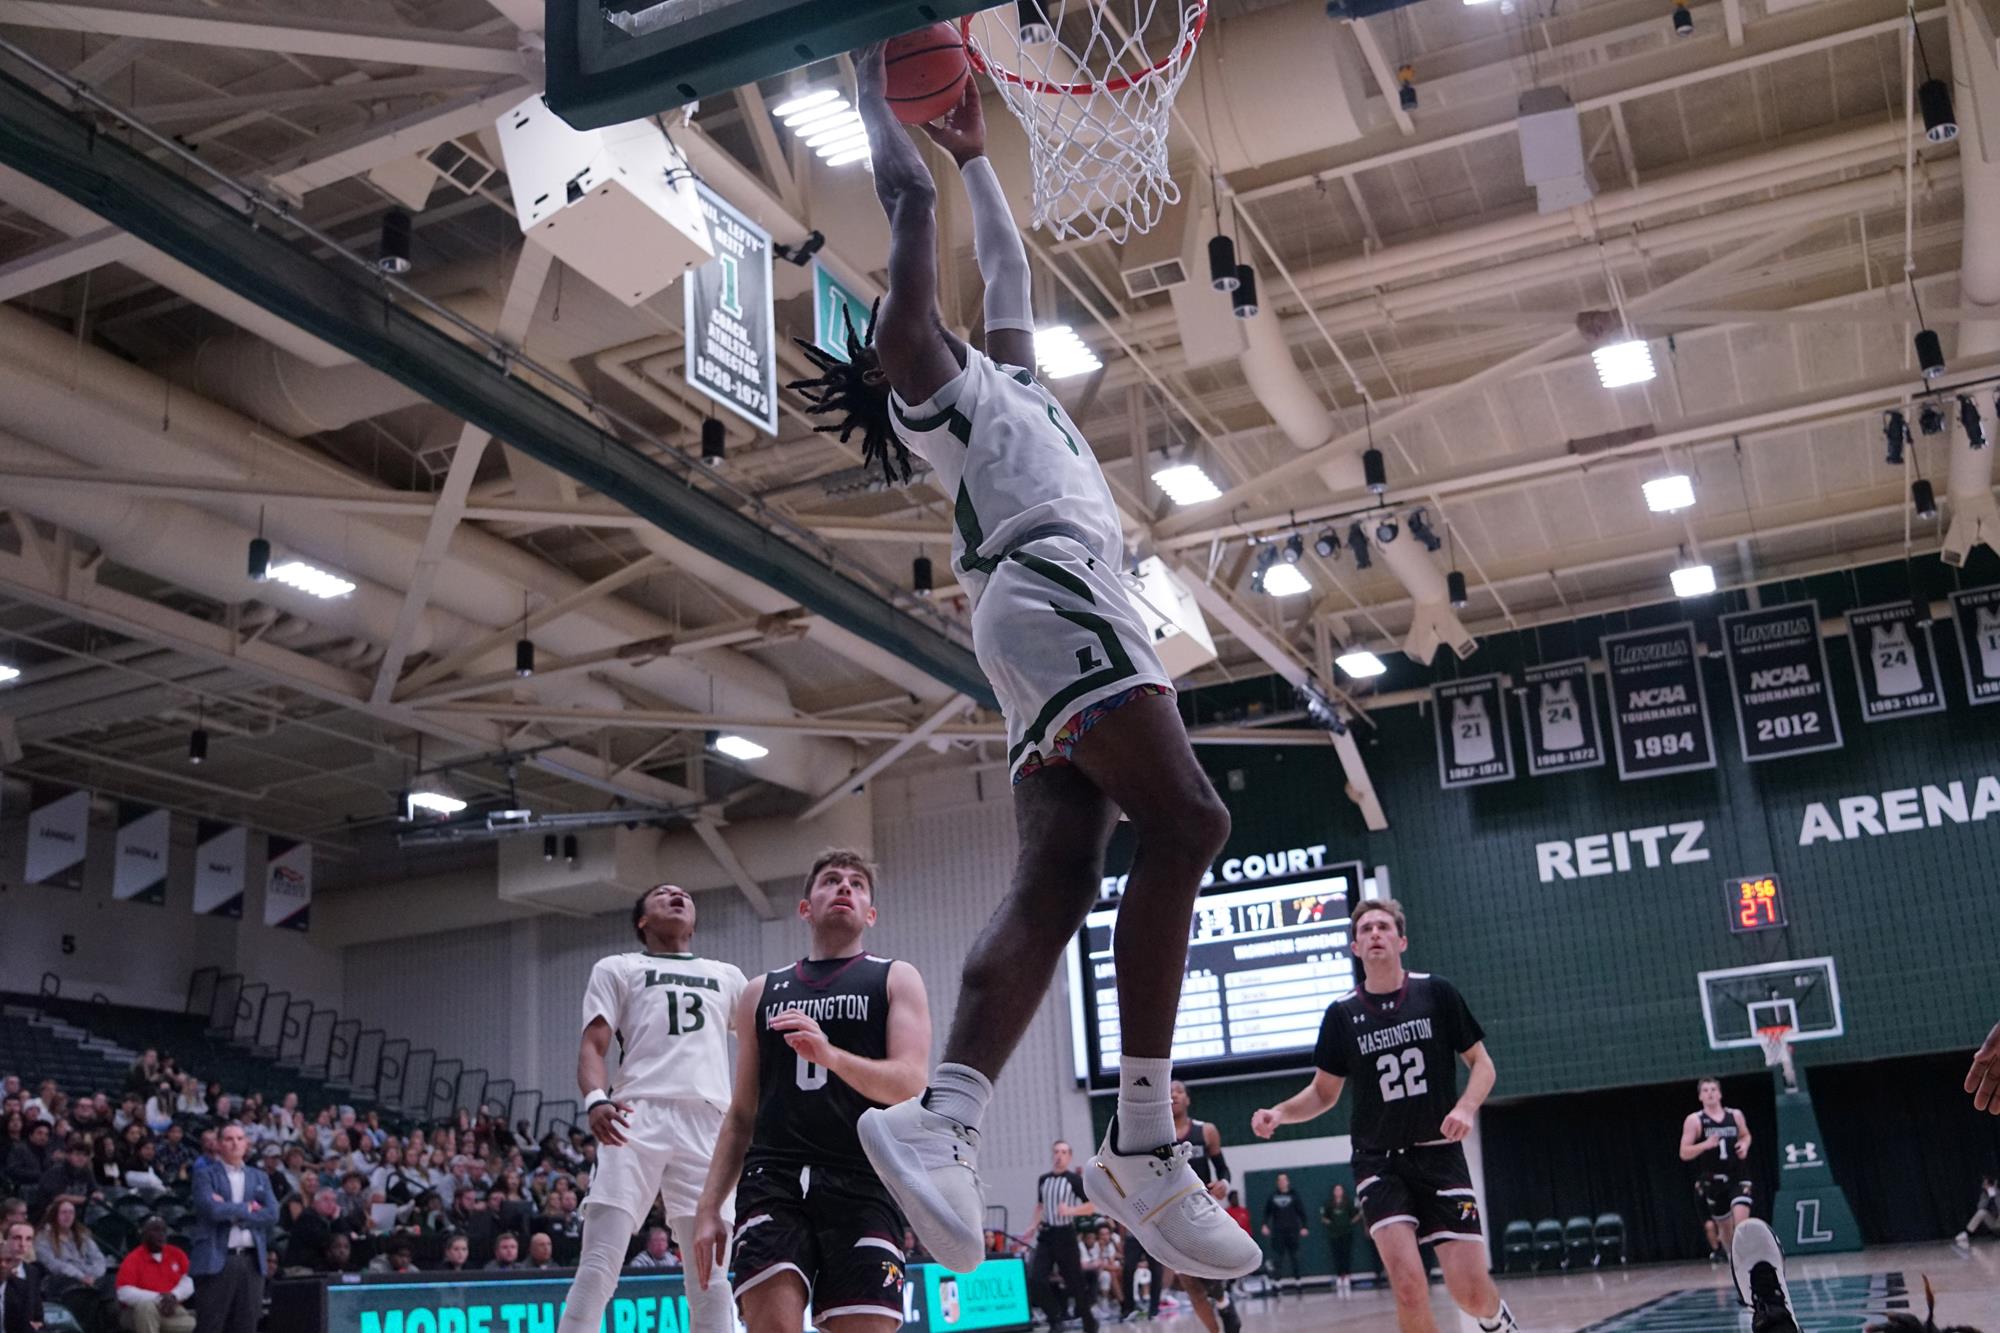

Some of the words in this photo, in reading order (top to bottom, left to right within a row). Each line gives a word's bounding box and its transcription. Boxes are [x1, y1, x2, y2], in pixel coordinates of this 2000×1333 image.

[1880, 651, 1907, 668] 24
[1750, 664, 1810, 690] NCAA
[1628, 684, 1687, 709] NCAA
[1744, 682, 1821, 705] TOURNAMENT
[1548, 707, 1572, 723] 24
[1621, 704, 1698, 724] TOURNAMENT
[1757, 712, 1820, 741] 2012
[1461, 724, 1481, 739] 21
[1634, 731, 1695, 759] 1994
[1222, 844, 1327, 882] COURT
[1535, 820, 1710, 883] REITZ
[1740, 897, 1775, 926] 27
[61, 934, 76, 954] 5
[645, 969, 720, 993] LOYOLA
[665, 990, 705, 1036] 13
[1357, 1018, 1433, 1055] WASHINGTON
[1376, 1047, 1427, 1102] 22
[1719, 1138, 1728, 1160] 1
[1795, 1198, 1833, 1245] L
